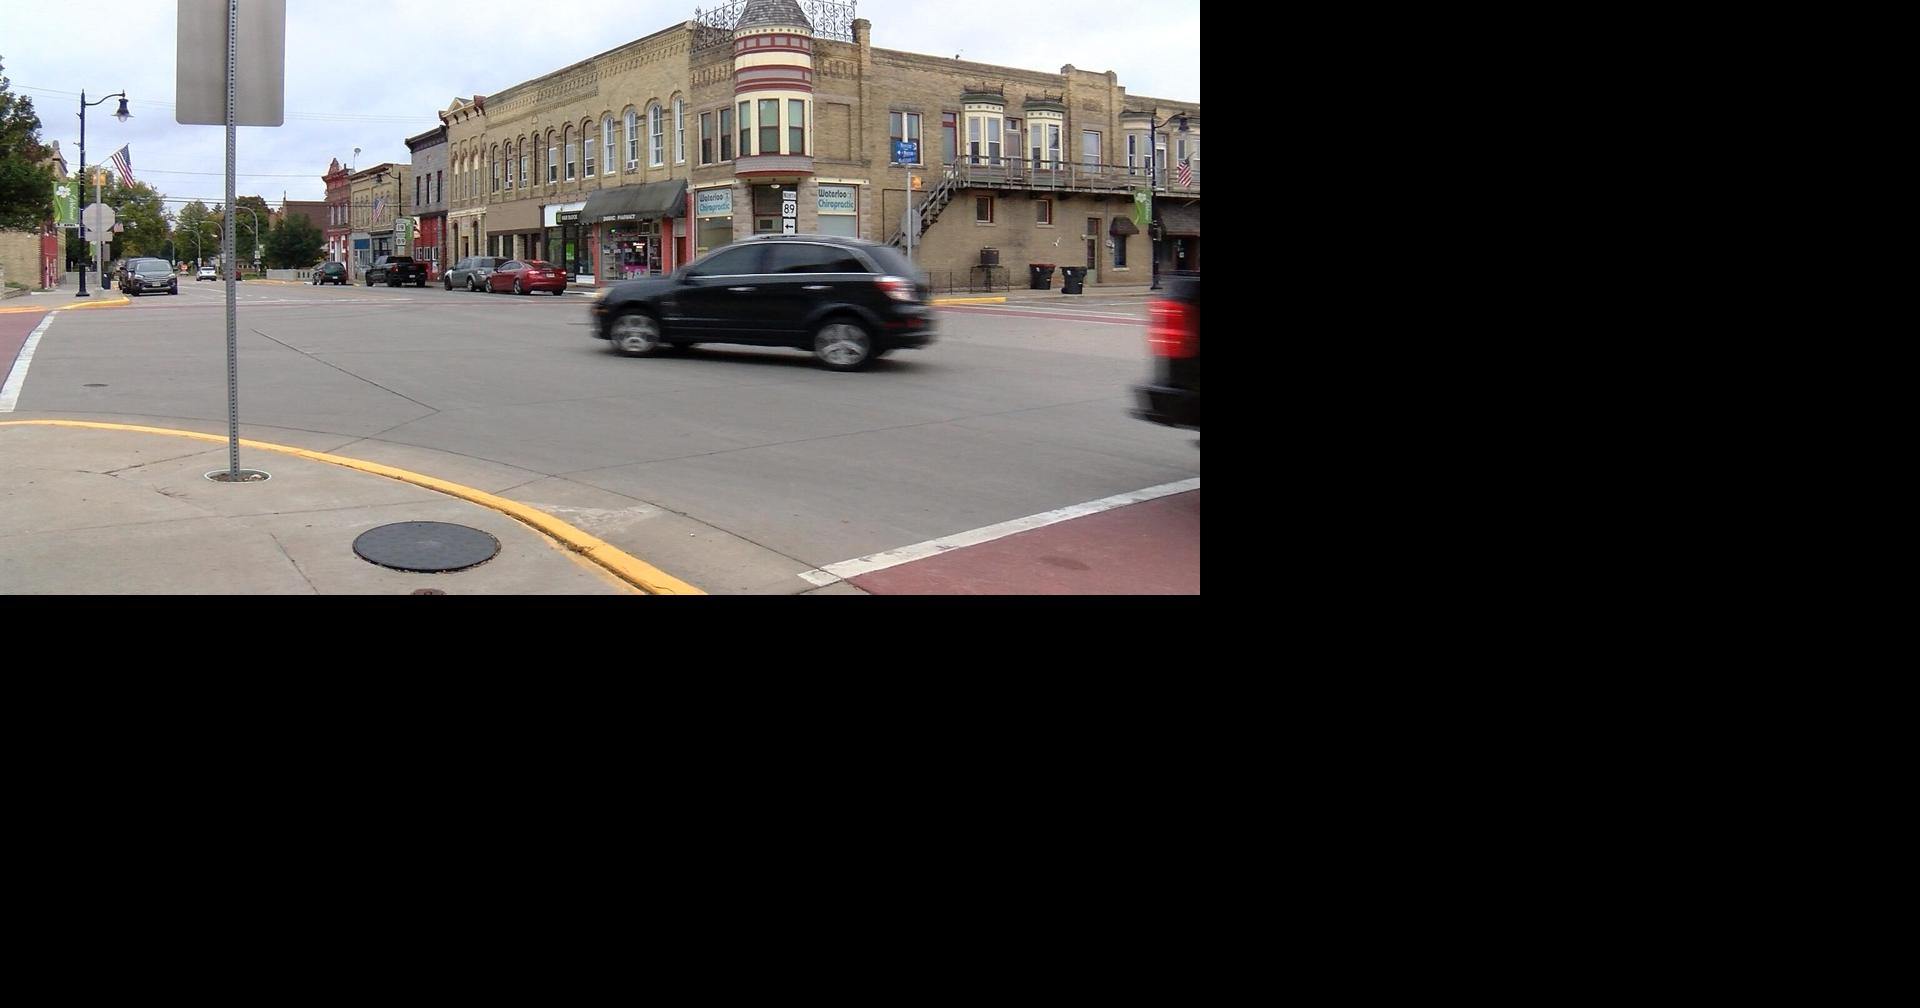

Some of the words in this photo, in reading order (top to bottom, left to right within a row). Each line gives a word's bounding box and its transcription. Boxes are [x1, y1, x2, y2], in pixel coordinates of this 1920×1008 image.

[699, 193, 723, 202] Waterloo
[819, 189, 847, 198] Waterloo
[699, 203, 730, 213] Chiropractic
[784, 203, 795, 214] 89
[819, 199, 854, 210] Chiropractic
